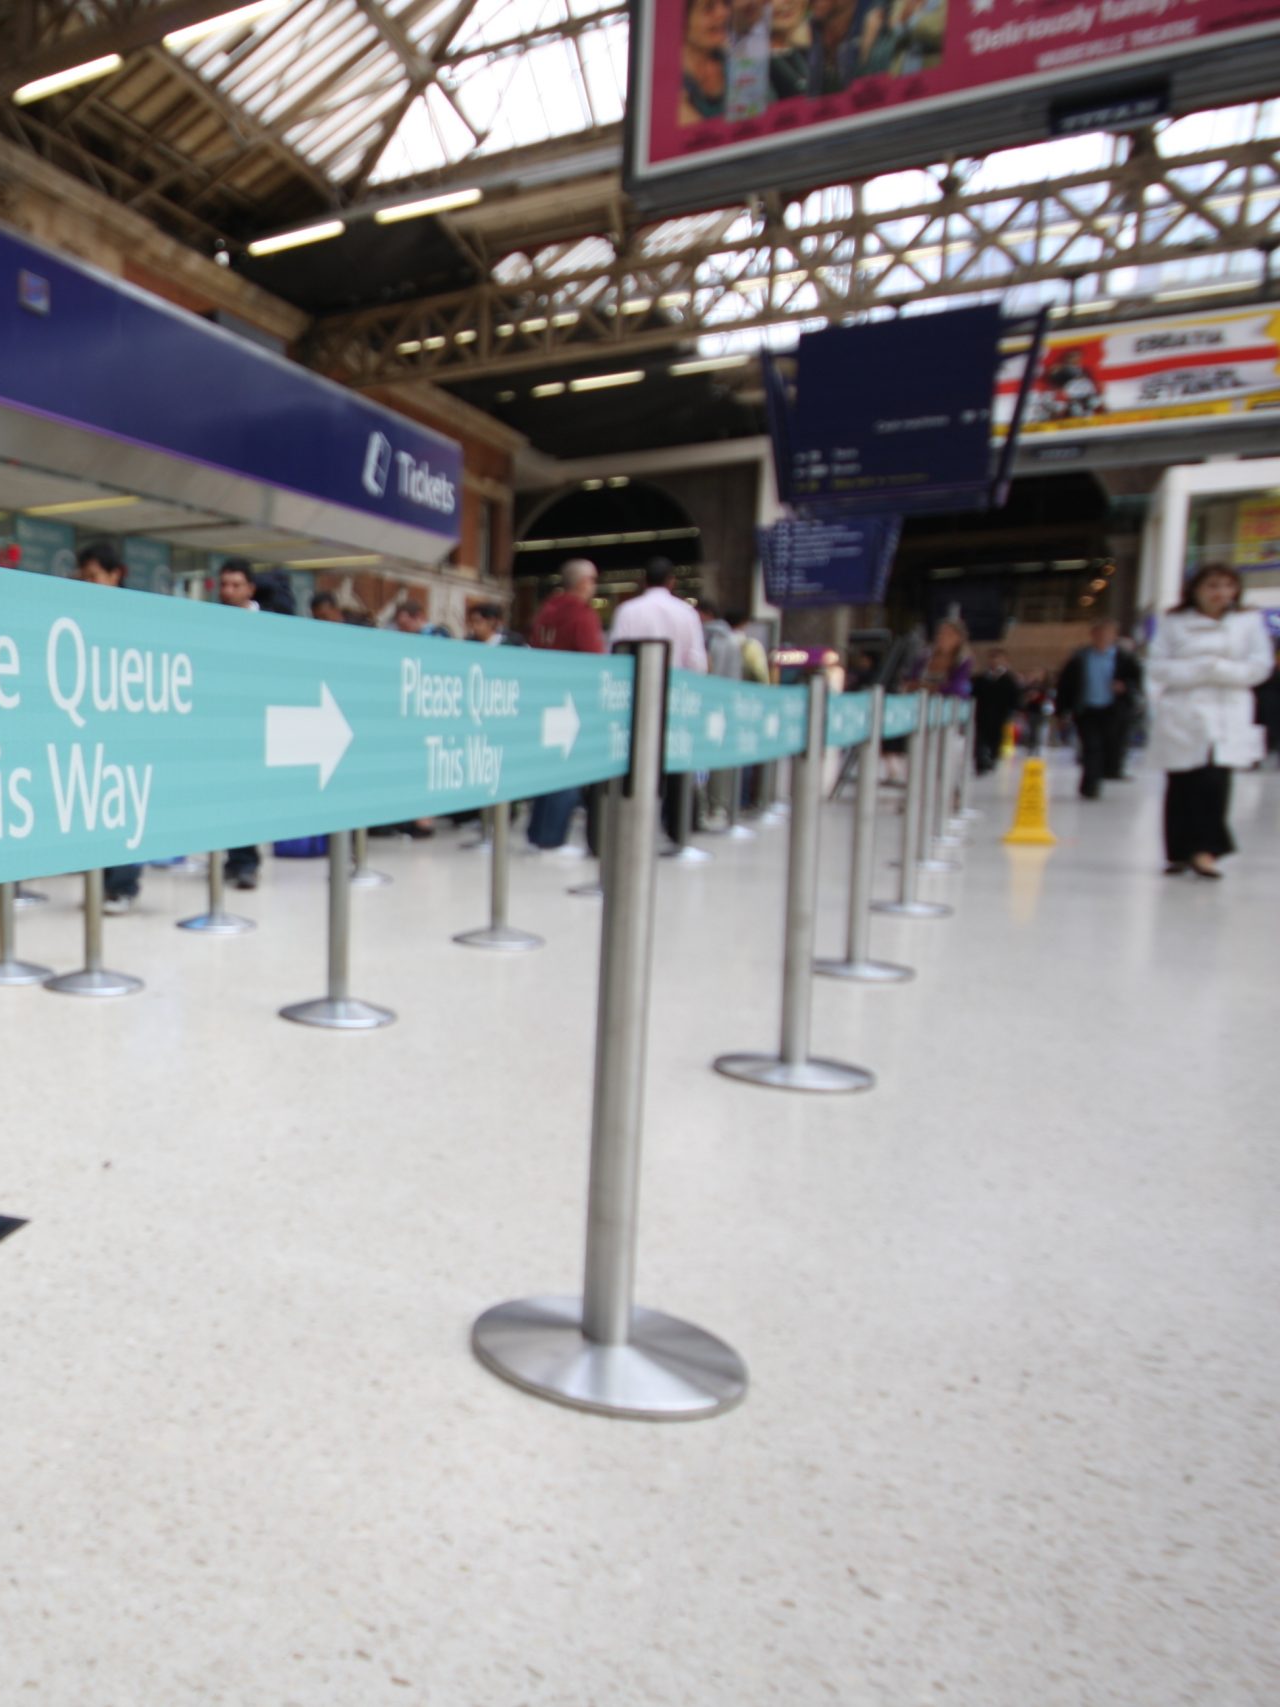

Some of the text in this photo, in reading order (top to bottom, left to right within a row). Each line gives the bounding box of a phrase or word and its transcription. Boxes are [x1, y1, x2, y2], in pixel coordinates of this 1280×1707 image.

[394, 450, 455, 515] Tickets
[46, 616, 193, 728] Queue
[401, 657, 519, 726] Please Queue
[46, 742, 153, 850] Way
[425, 734, 503, 796] This Way
